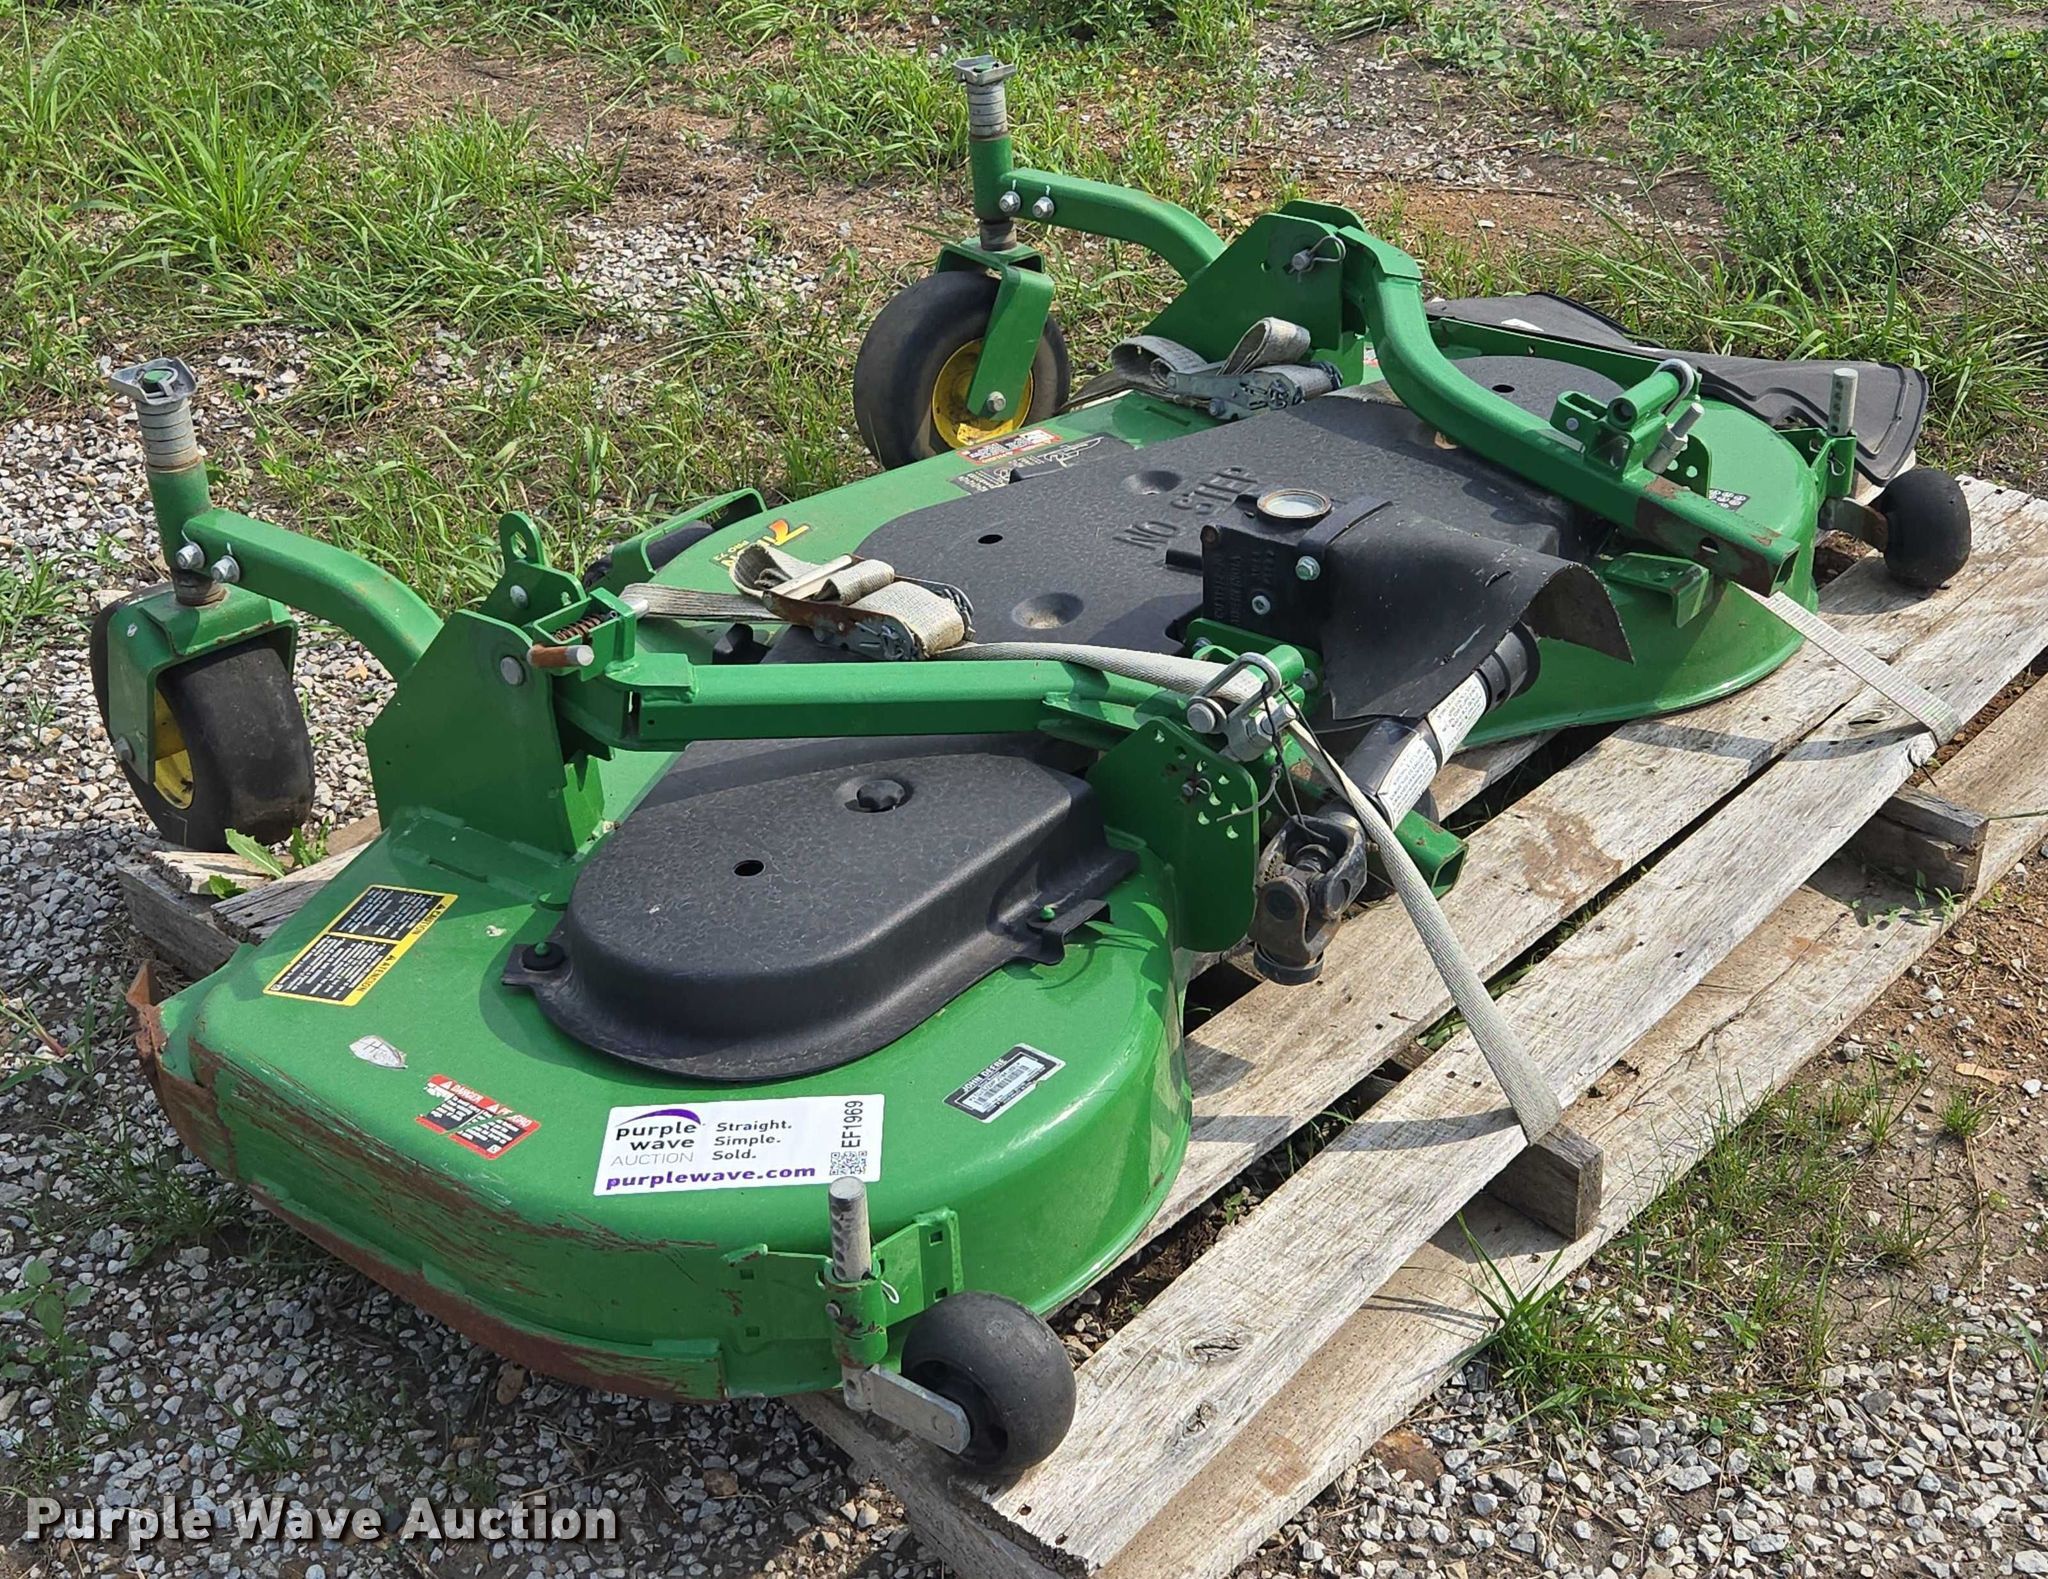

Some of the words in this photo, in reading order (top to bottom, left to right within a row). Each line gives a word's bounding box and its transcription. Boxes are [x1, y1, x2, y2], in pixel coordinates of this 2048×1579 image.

[1111, 520, 1178, 551] NO
[961, 1075, 984, 1092] JOHN
[980, 1058, 1006, 1077] DEERE
[615, 1120, 698, 1141] purple
[716, 1119, 793, 1133] Straight.
[841, 1100, 864, 1149] EF1969
[630, 1137, 695, 1151] wave
[714, 1134, 781, 1148] Simple.
[610, 1152, 694, 1167] AUCTION
[712, 1149, 757, 1161] Sold.
[606, 1165, 816, 1190] purplewave.com
